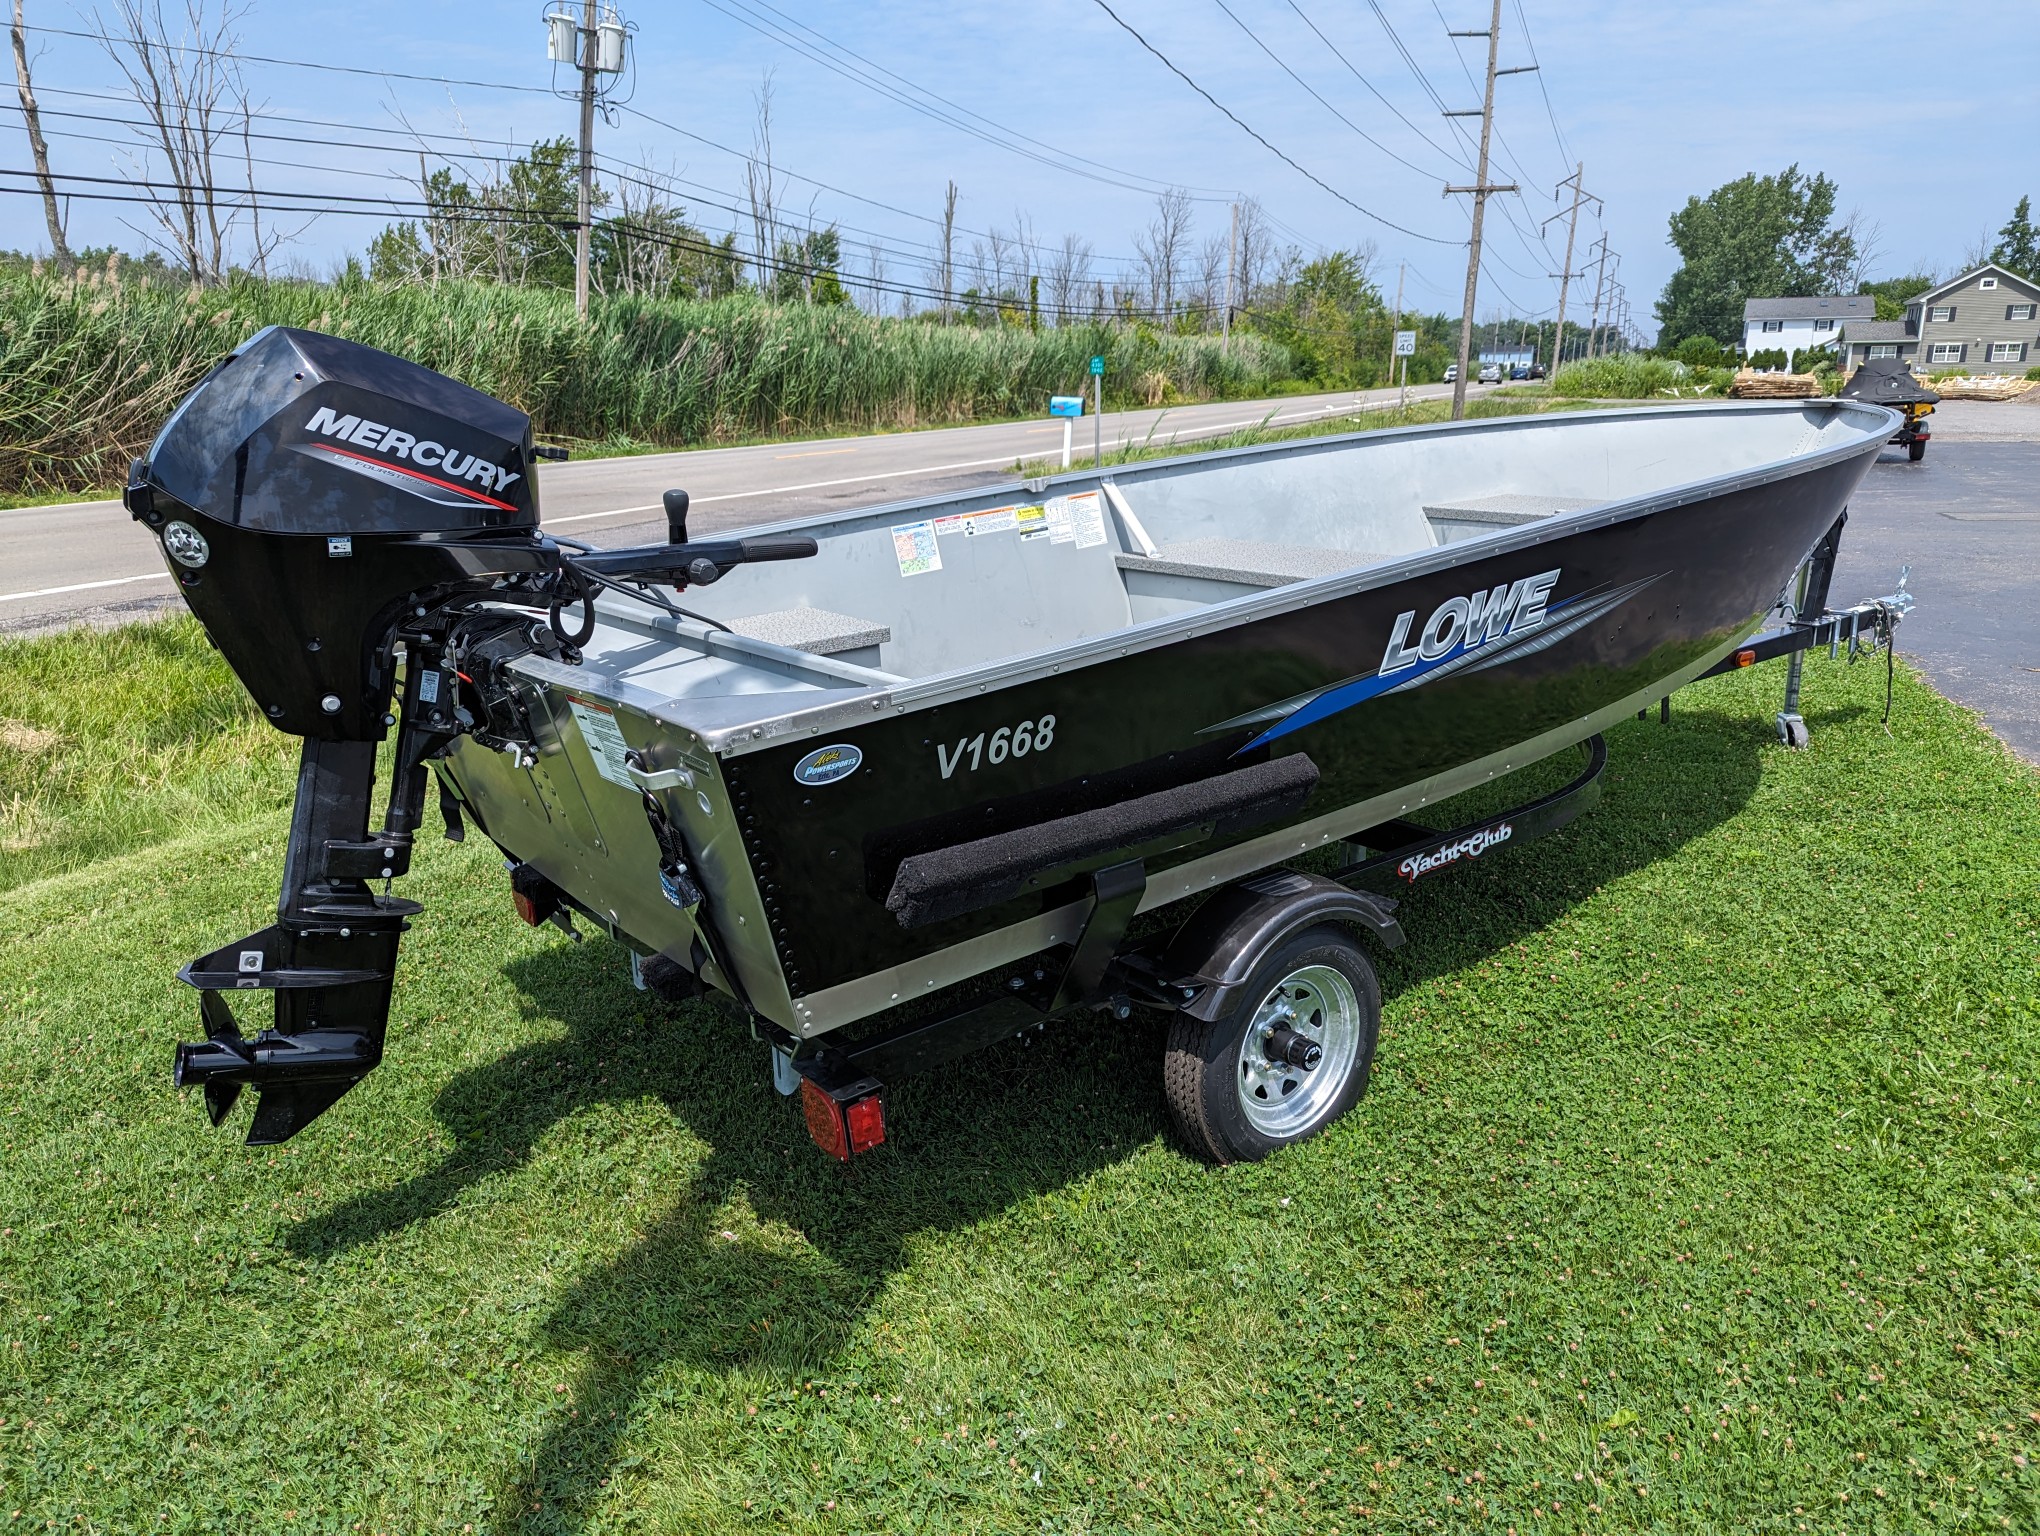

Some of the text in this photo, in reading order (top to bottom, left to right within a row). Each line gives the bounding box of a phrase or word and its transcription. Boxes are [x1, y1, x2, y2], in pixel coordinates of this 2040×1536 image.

[1398, 343, 1413, 352] 40
[305, 406, 520, 492] MERCURY
[1378, 568, 1561, 679] LOWE
[937, 714, 1056, 779] V1668
